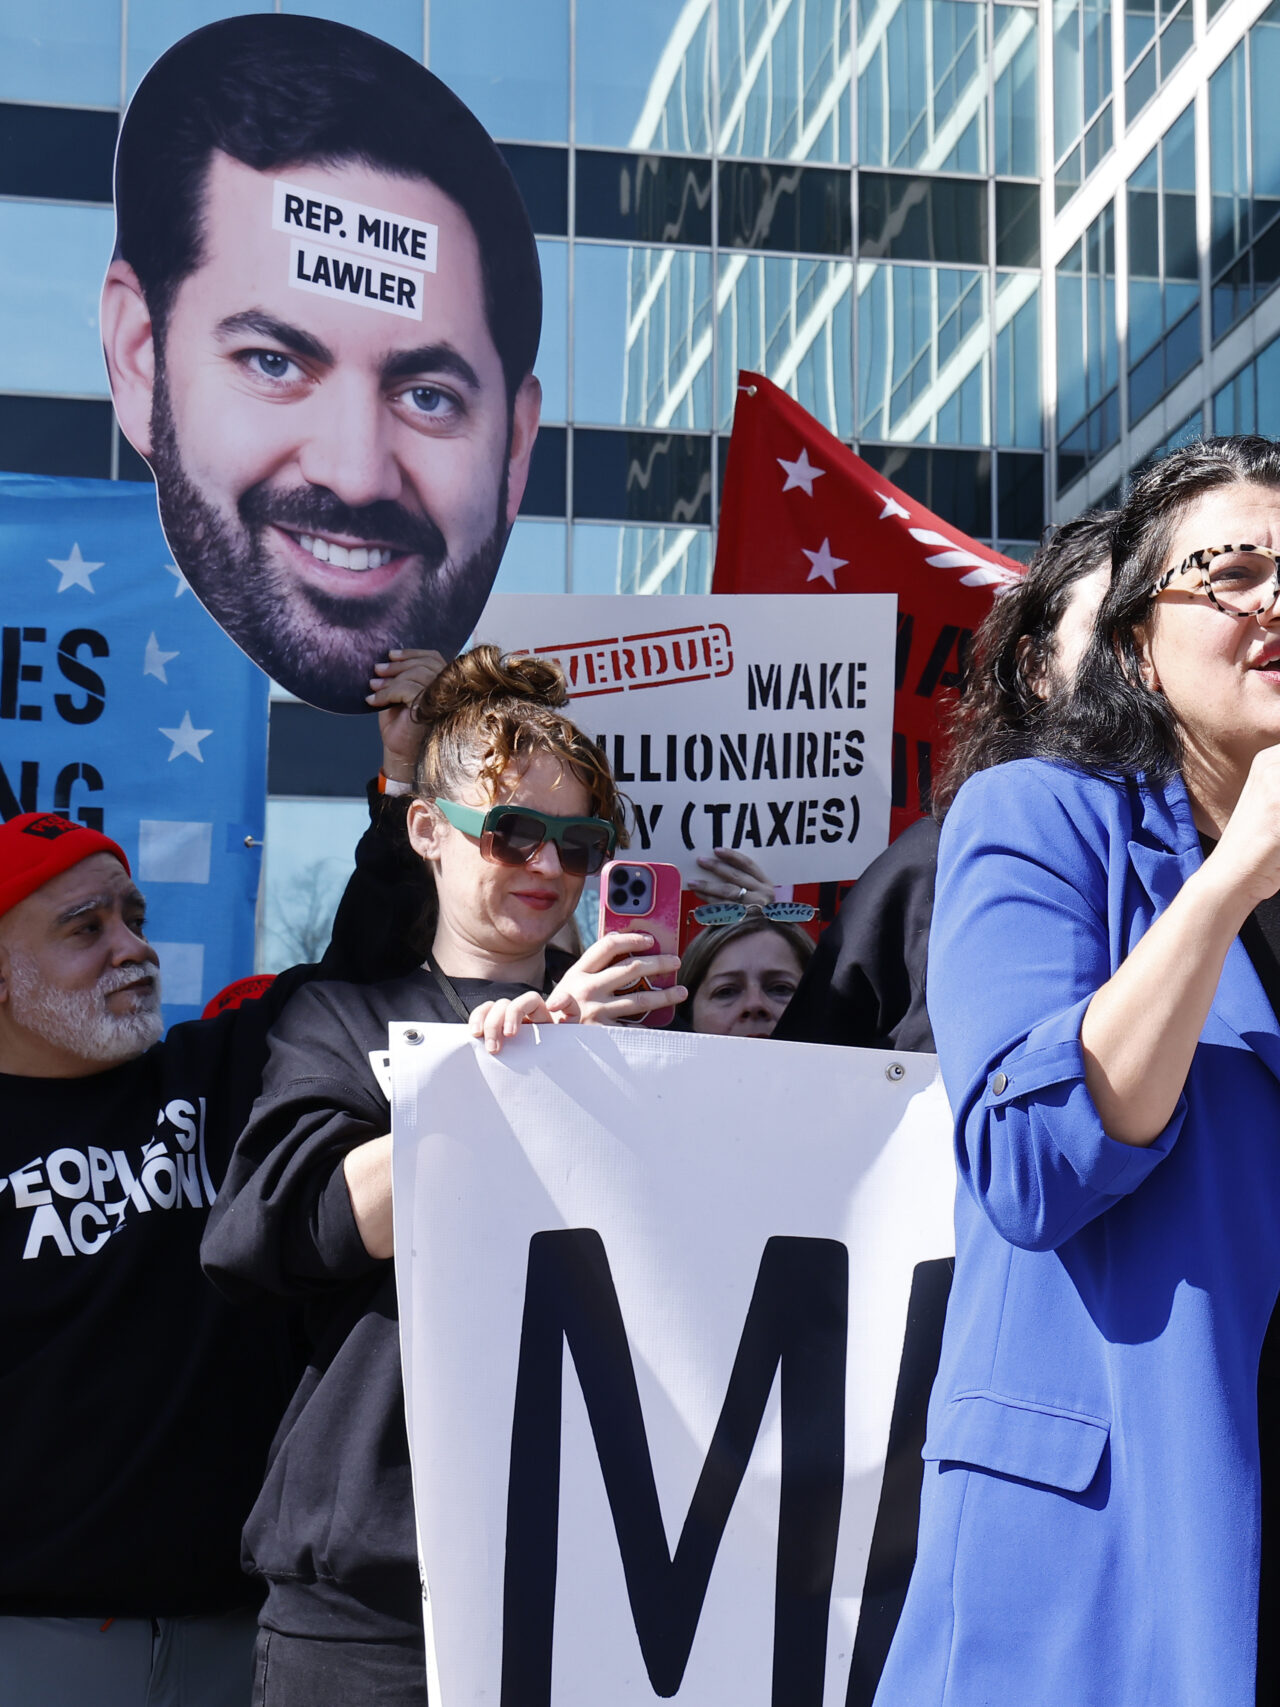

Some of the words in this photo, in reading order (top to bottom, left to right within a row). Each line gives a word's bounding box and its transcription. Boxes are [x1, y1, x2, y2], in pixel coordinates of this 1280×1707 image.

[284, 193, 347, 239] REP.
[357, 213, 428, 261] MIKE
[296, 249, 417, 310] LAWLER
[552, 634, 726, 687] VERDUE
[748, 662, 867, 710] MAKE
[681, 794, 861, 850] (TAXES)
